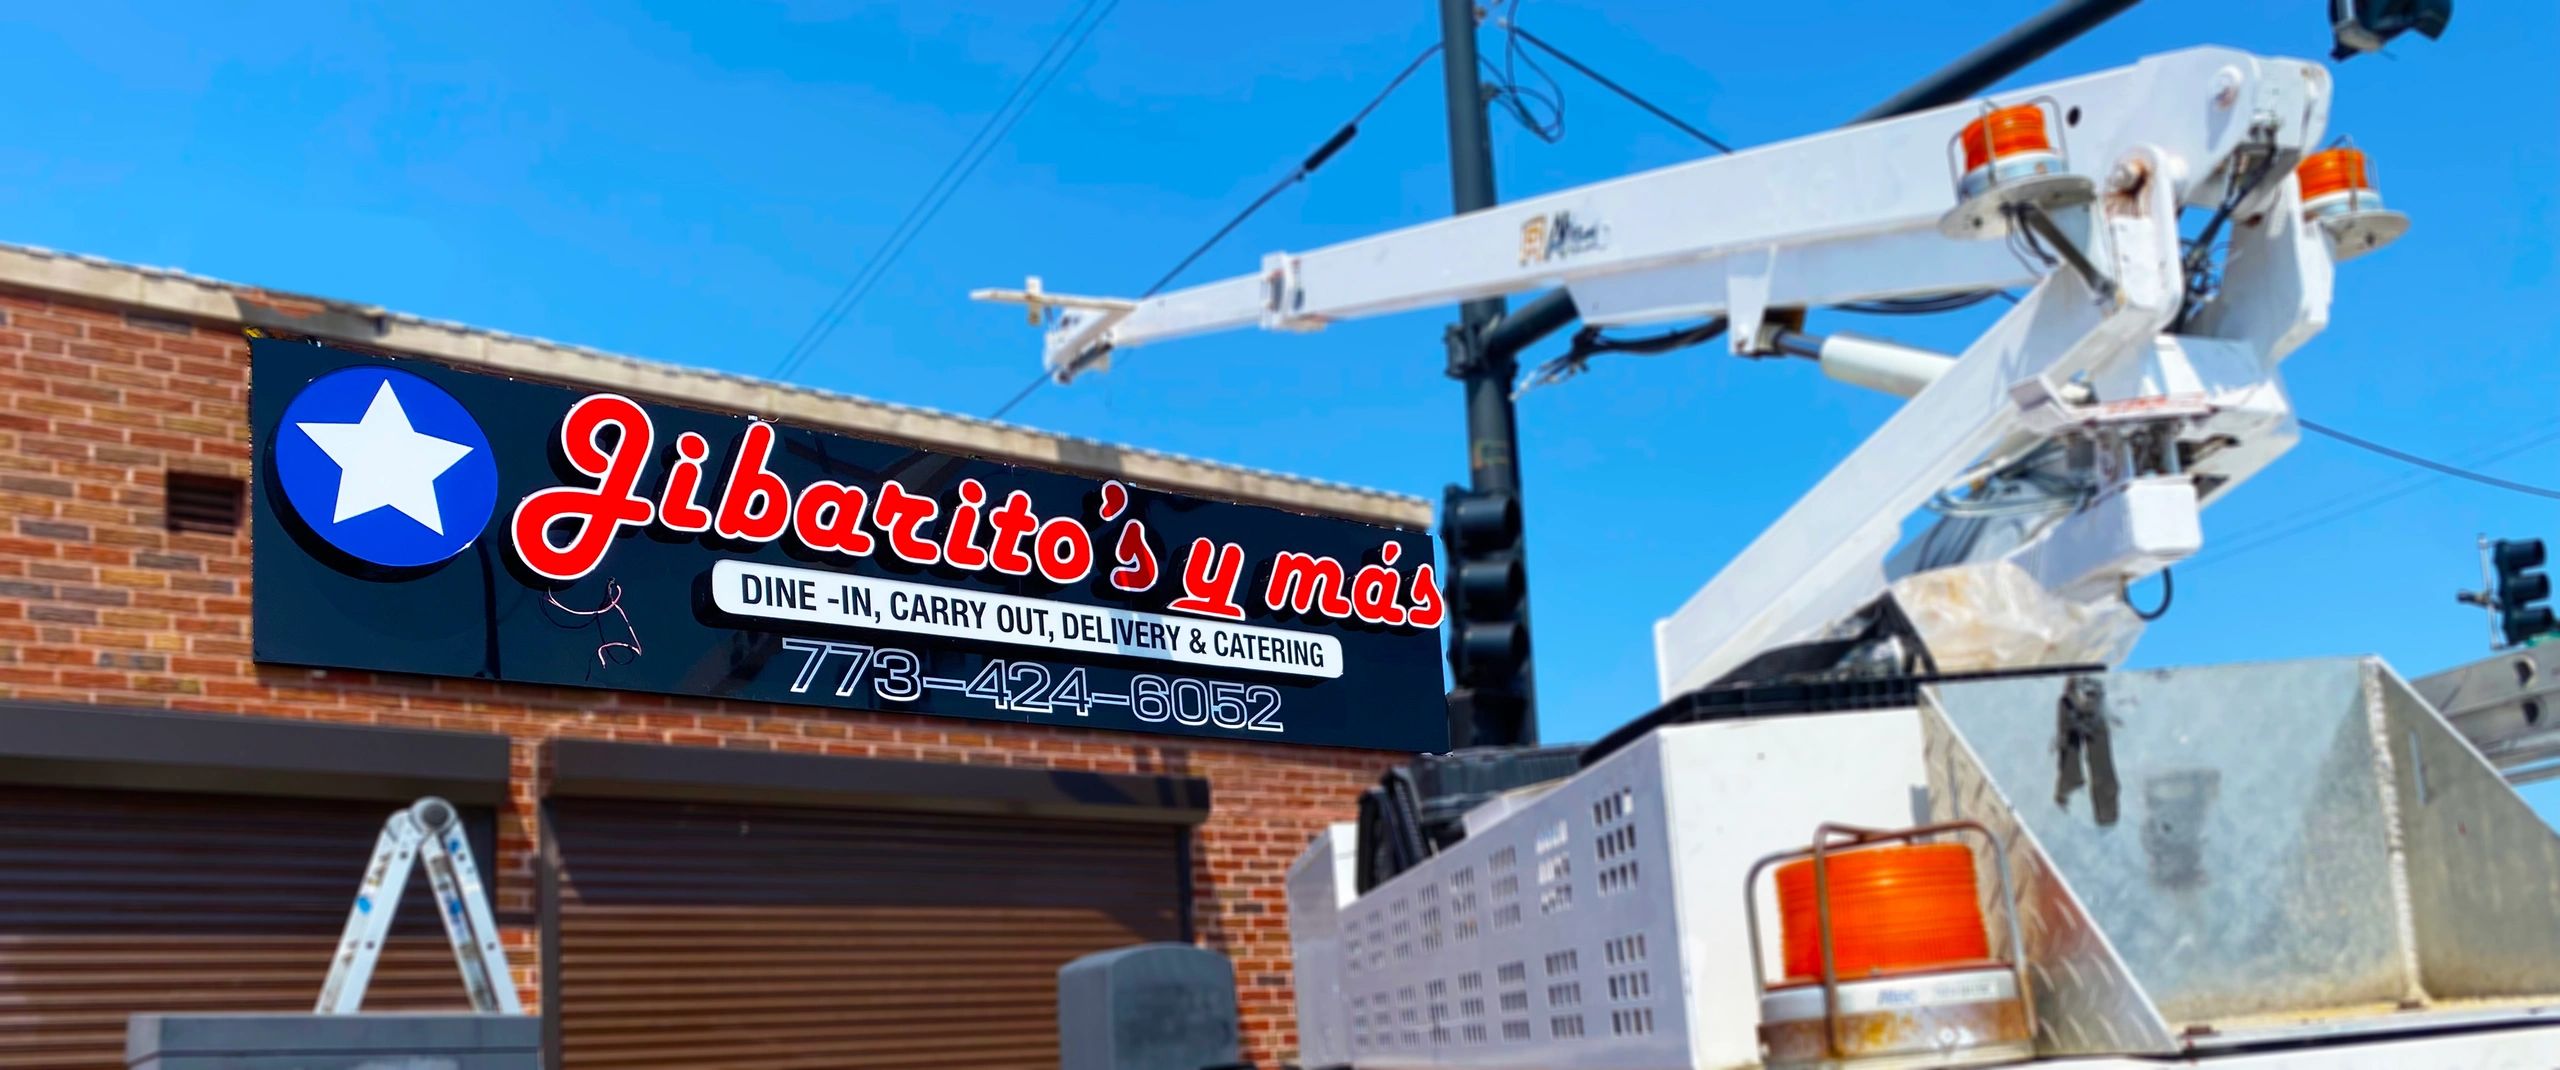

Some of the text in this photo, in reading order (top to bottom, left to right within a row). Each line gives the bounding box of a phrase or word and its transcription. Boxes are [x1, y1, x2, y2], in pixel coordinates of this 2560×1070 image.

[511, 393, 1445, 629] Jibarito's y más
[741, 573, 1325, 669] DINE -IN, CARRY OUT, DELIVERY & CATERING
[783, 637, 1284, 733] 773-424-6052
